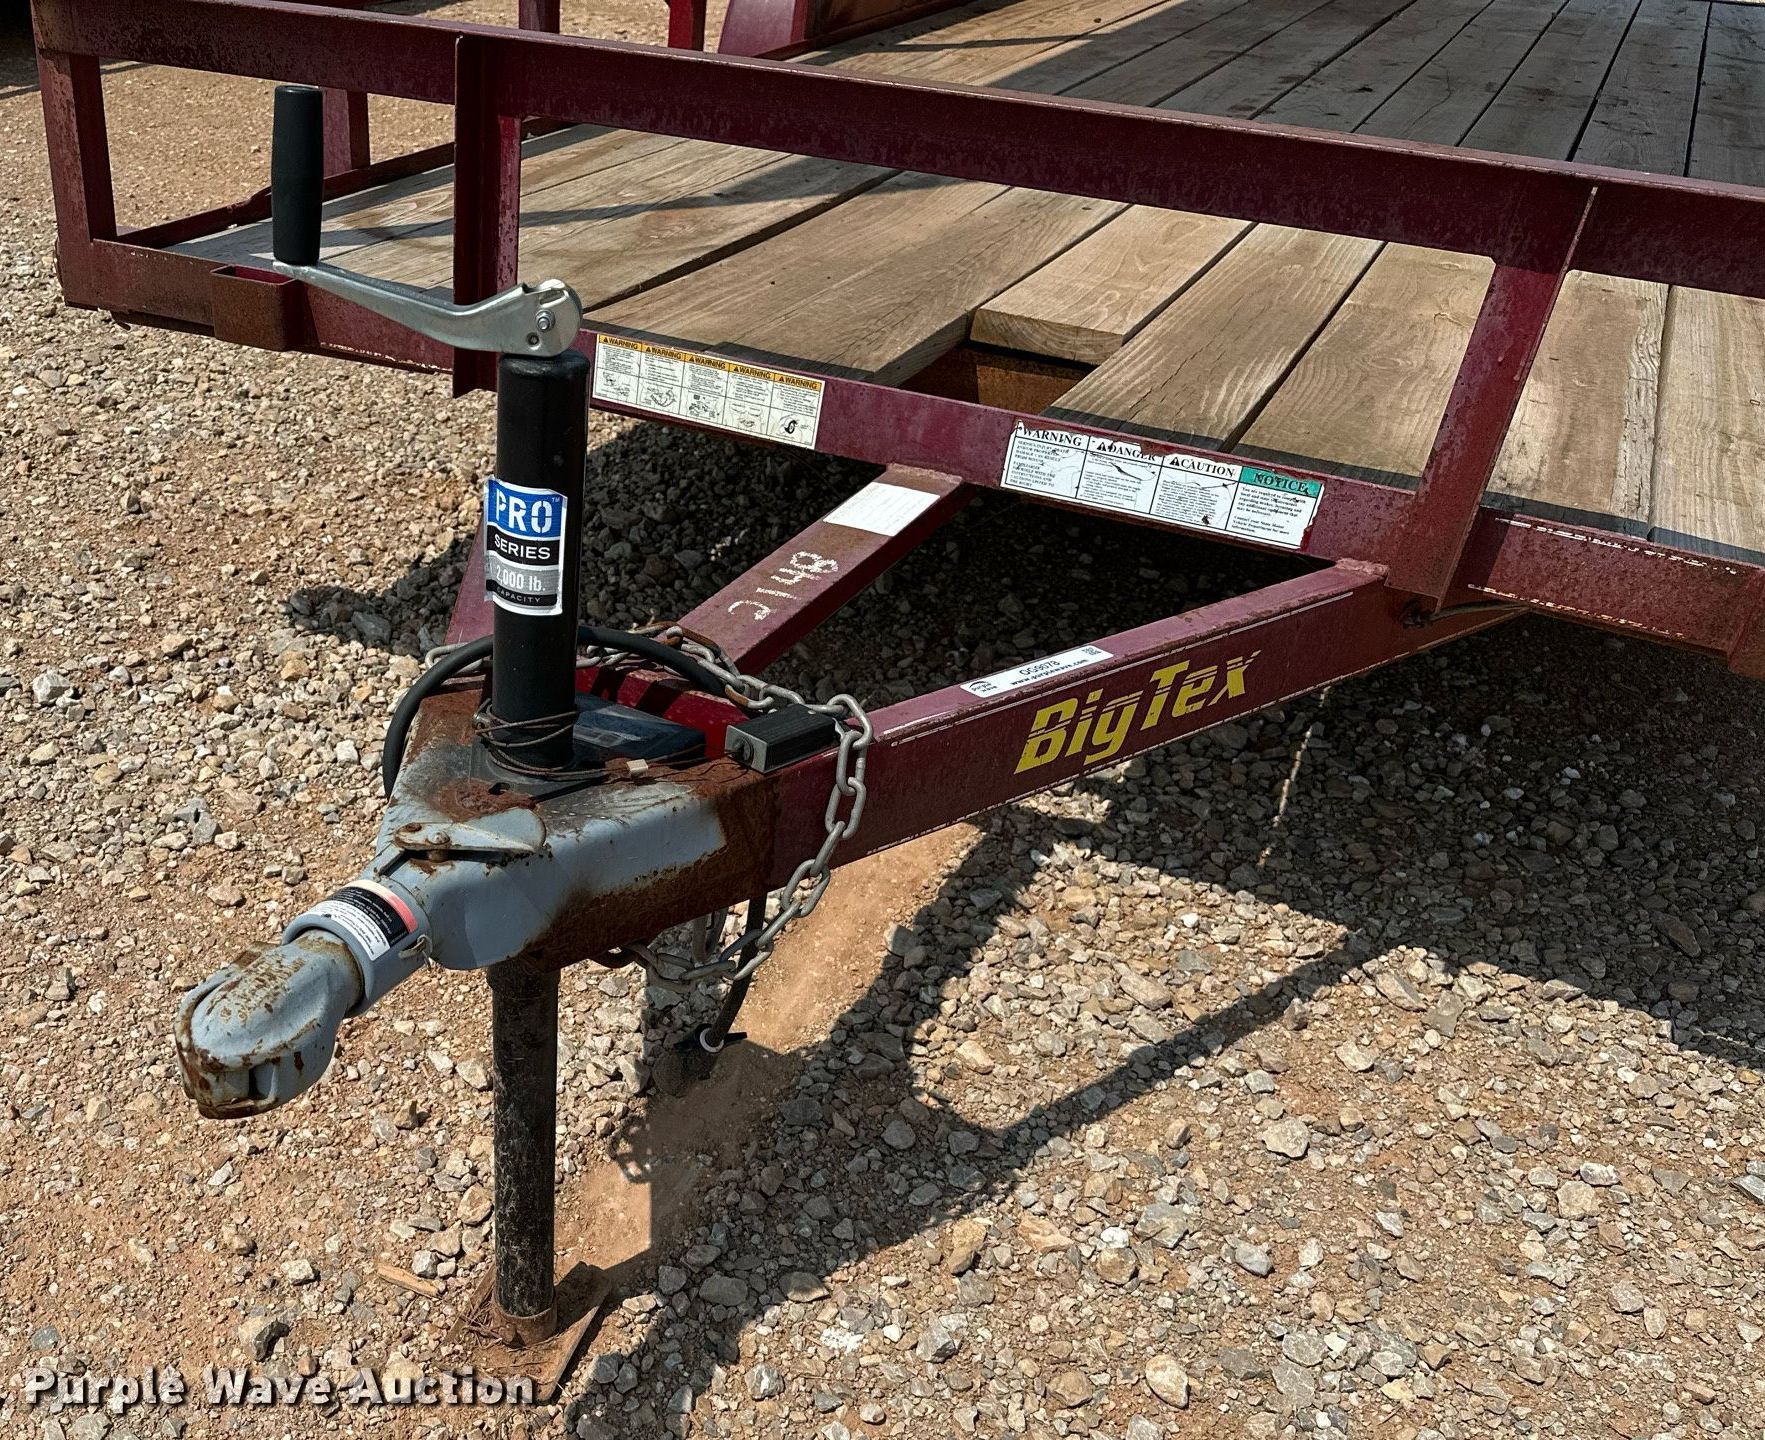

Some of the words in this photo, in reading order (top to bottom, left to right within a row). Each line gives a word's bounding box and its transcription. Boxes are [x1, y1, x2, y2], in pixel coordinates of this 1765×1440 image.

[608, 337, 638, 350] WARNING
[651, 347, 682, 360] WARNING
[695, 357, 726, 369] WARNING
[738, 366, 771, 379] WARNING
[784, 377, 817, 389] WARNING
[1022, 428, 1082, 447] WARNING
[1181, 457, 1235, 477] CAUTION
[1253, 472, 1308, 493] NOTICE
[496, 488, 552, 534] PRO
[494, 533, 550, 560] SERIES
[496, 565, 524, 590] 2,000
[529, 576, 546, 591] lb.
[496, 586, 541, 603] CAPACITY
